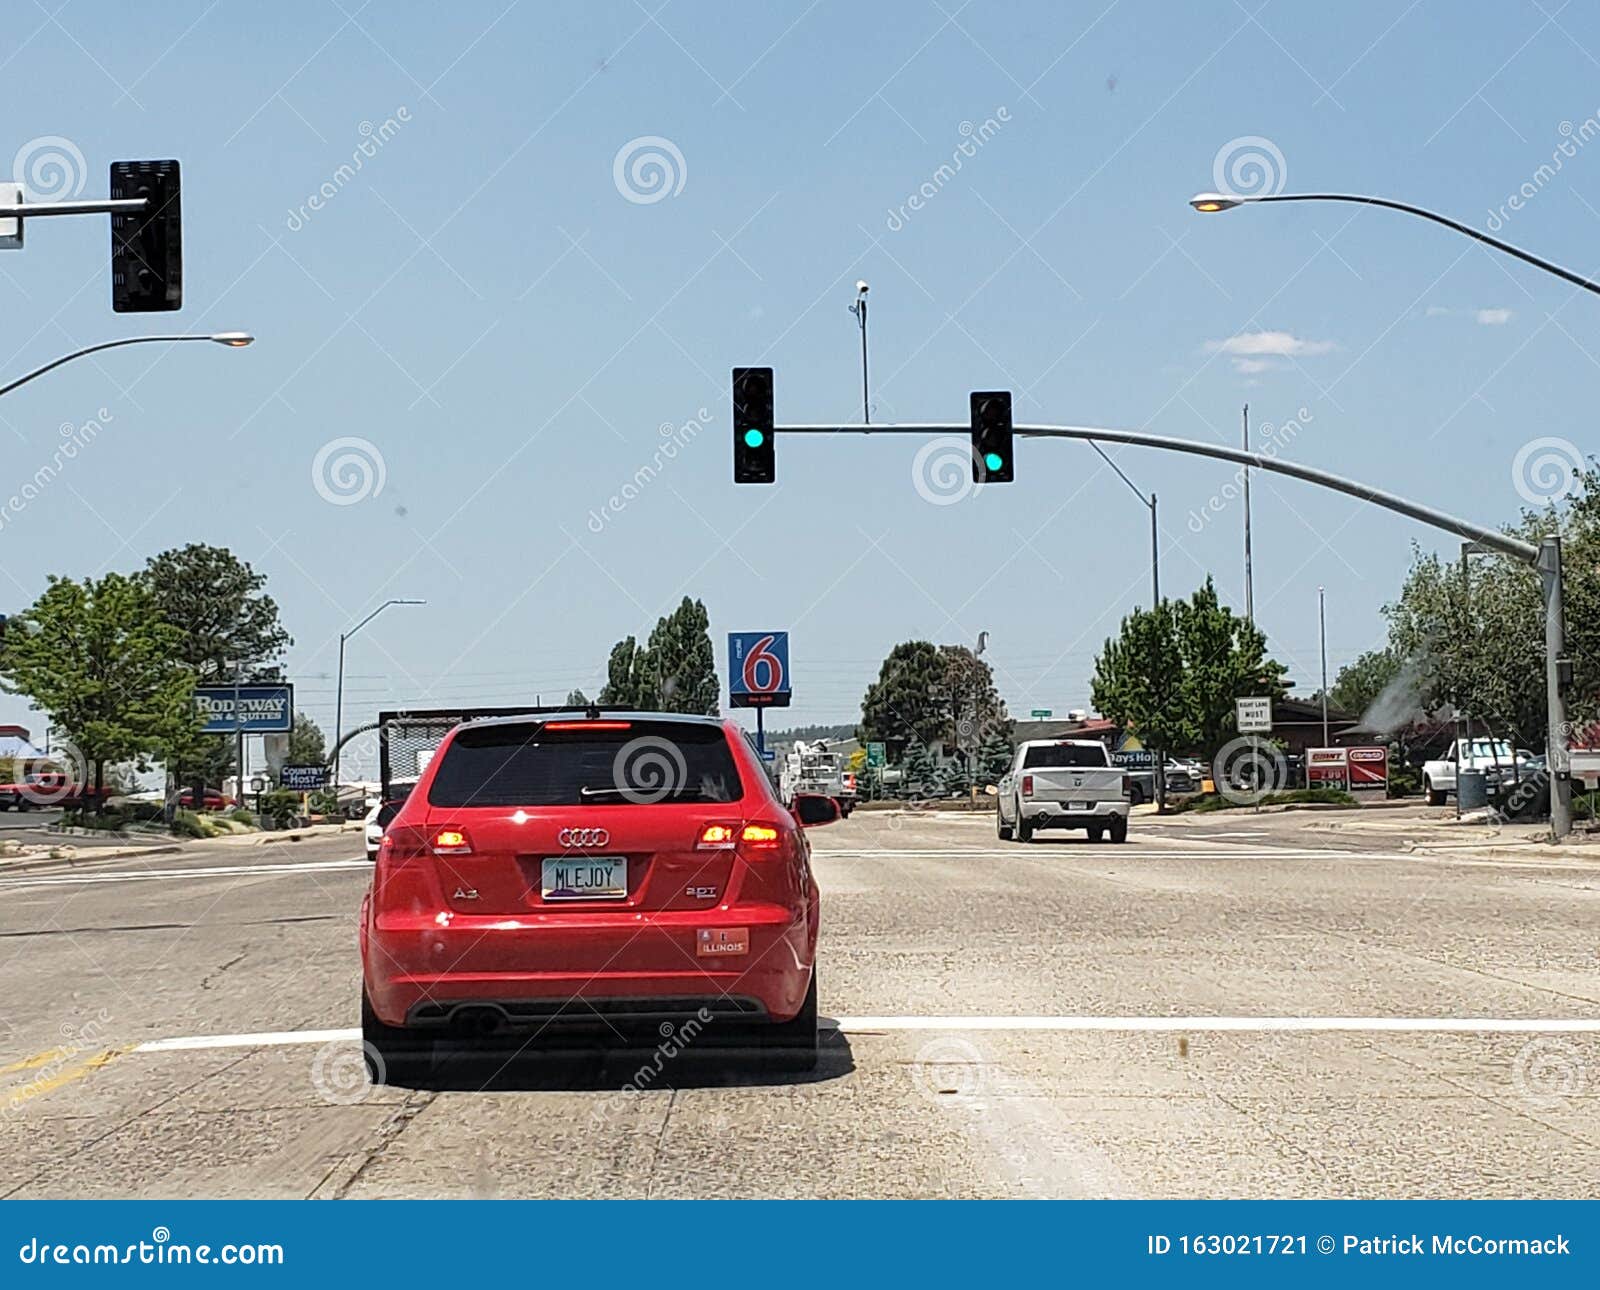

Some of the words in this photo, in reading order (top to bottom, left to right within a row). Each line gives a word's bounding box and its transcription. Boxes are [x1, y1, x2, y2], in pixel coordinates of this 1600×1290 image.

[742, 635, 783, 693] 6
[282, 766, 324, 776] COUNTRY
[290, 775, 316, 784] HOST
[555, 868, 613, 892] MLEJOY
[703, 943, 744, 953] ILLINOIS
